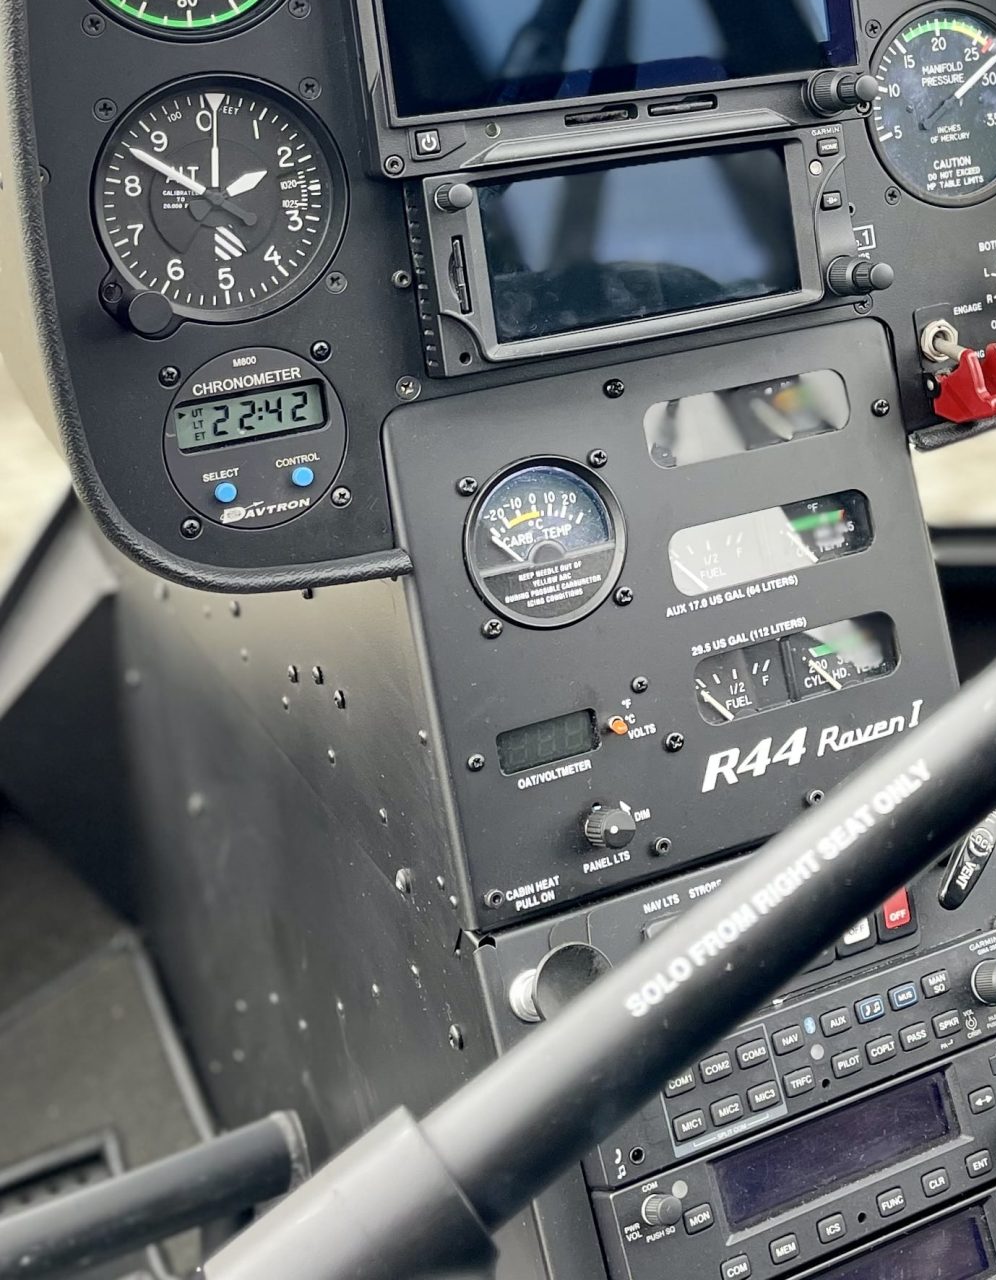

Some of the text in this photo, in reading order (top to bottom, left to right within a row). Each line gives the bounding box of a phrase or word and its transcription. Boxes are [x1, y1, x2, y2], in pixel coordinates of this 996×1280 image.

[931, 37, 946, 51] 20
[964, 48, 980, 62] 25
[922, 61, 963, 75] MANIFOLD
[922, 74, 965, 87] PRESSURE
[982, 72, 996, 86] 30
[811, 127, 840, 136] GARMIN
[937, 124, 961, 133] INCHES
[930, 132, 970, 144] OF MERCURY
[933, 156, 971, 170] CAUTION
[928, 167, 980, 181] DO NOT EXCEED
[281, 180, 297, 190] 1020
[927, 175, 984, 190] MP TABLE LIMITS
[282, 200, 299, 209] 1025
[954, 302, 982, 315] ENGAGE
[233, 356, 257, 367] M800
[192, 367, 301, 396] CHRONOMETER
[191, 408, 204, 418] UT
[193, 420, 204, 429] LT
[195, 432, 206, 441] ET
[275, 453, 320, 468] CONTROL
[203, 468, 239, 482] SELECT
[544, 491, 576, 505] 10 20
[542, 524, 572, 539] TEMP
[533, 575, 557, 587] YELLOW
[666, 603, 687, 617] AUX
[709, 593, 724, 606] US
[724, 587, 746, 601] GAL
[762, 575, 799, 592] LITERS)
[713, 637, 728, 651] US
[728, 633, 748, 646] GAL
[750, 628, 769, 642] (112
[770, 617, 807, 636] LITERS)
[725, 696, 752, 710] FUEL
[628, 724, 656, 740] VOLTS
[701, 727, 807, 793] R44
[817, 716, 905, 757] Raven
[517, 760, 591, 790] OAT/VOLTMETER
[634, 809, 651, 822] DIM
[583, 851, 630, 874] PANEL LTS
[956, 861, 977, 890] VENT
[506, 875, 560, 901] CABIN HEAT
[625, 758, 931, 1018] SOLO FROM RIGHT SEAT ONLY
[516, 890, 555, 911] PULL ON
[643, 895, 680, 914] NAV LTS
[889, 909, 907, 922] OFF
[668, 974, 946, 1090] COM1 COM2 COM3 NAV AUX MAN
[681, 1017, 960, 1132] MIC1 MIC2 MIC3 TRFC PILOT COPLT PASS SPKR
[689, 1211, 710, 1227] MON
[727, 1157, 989, 1278] COM MEM ICS FUNC CLR ENT
